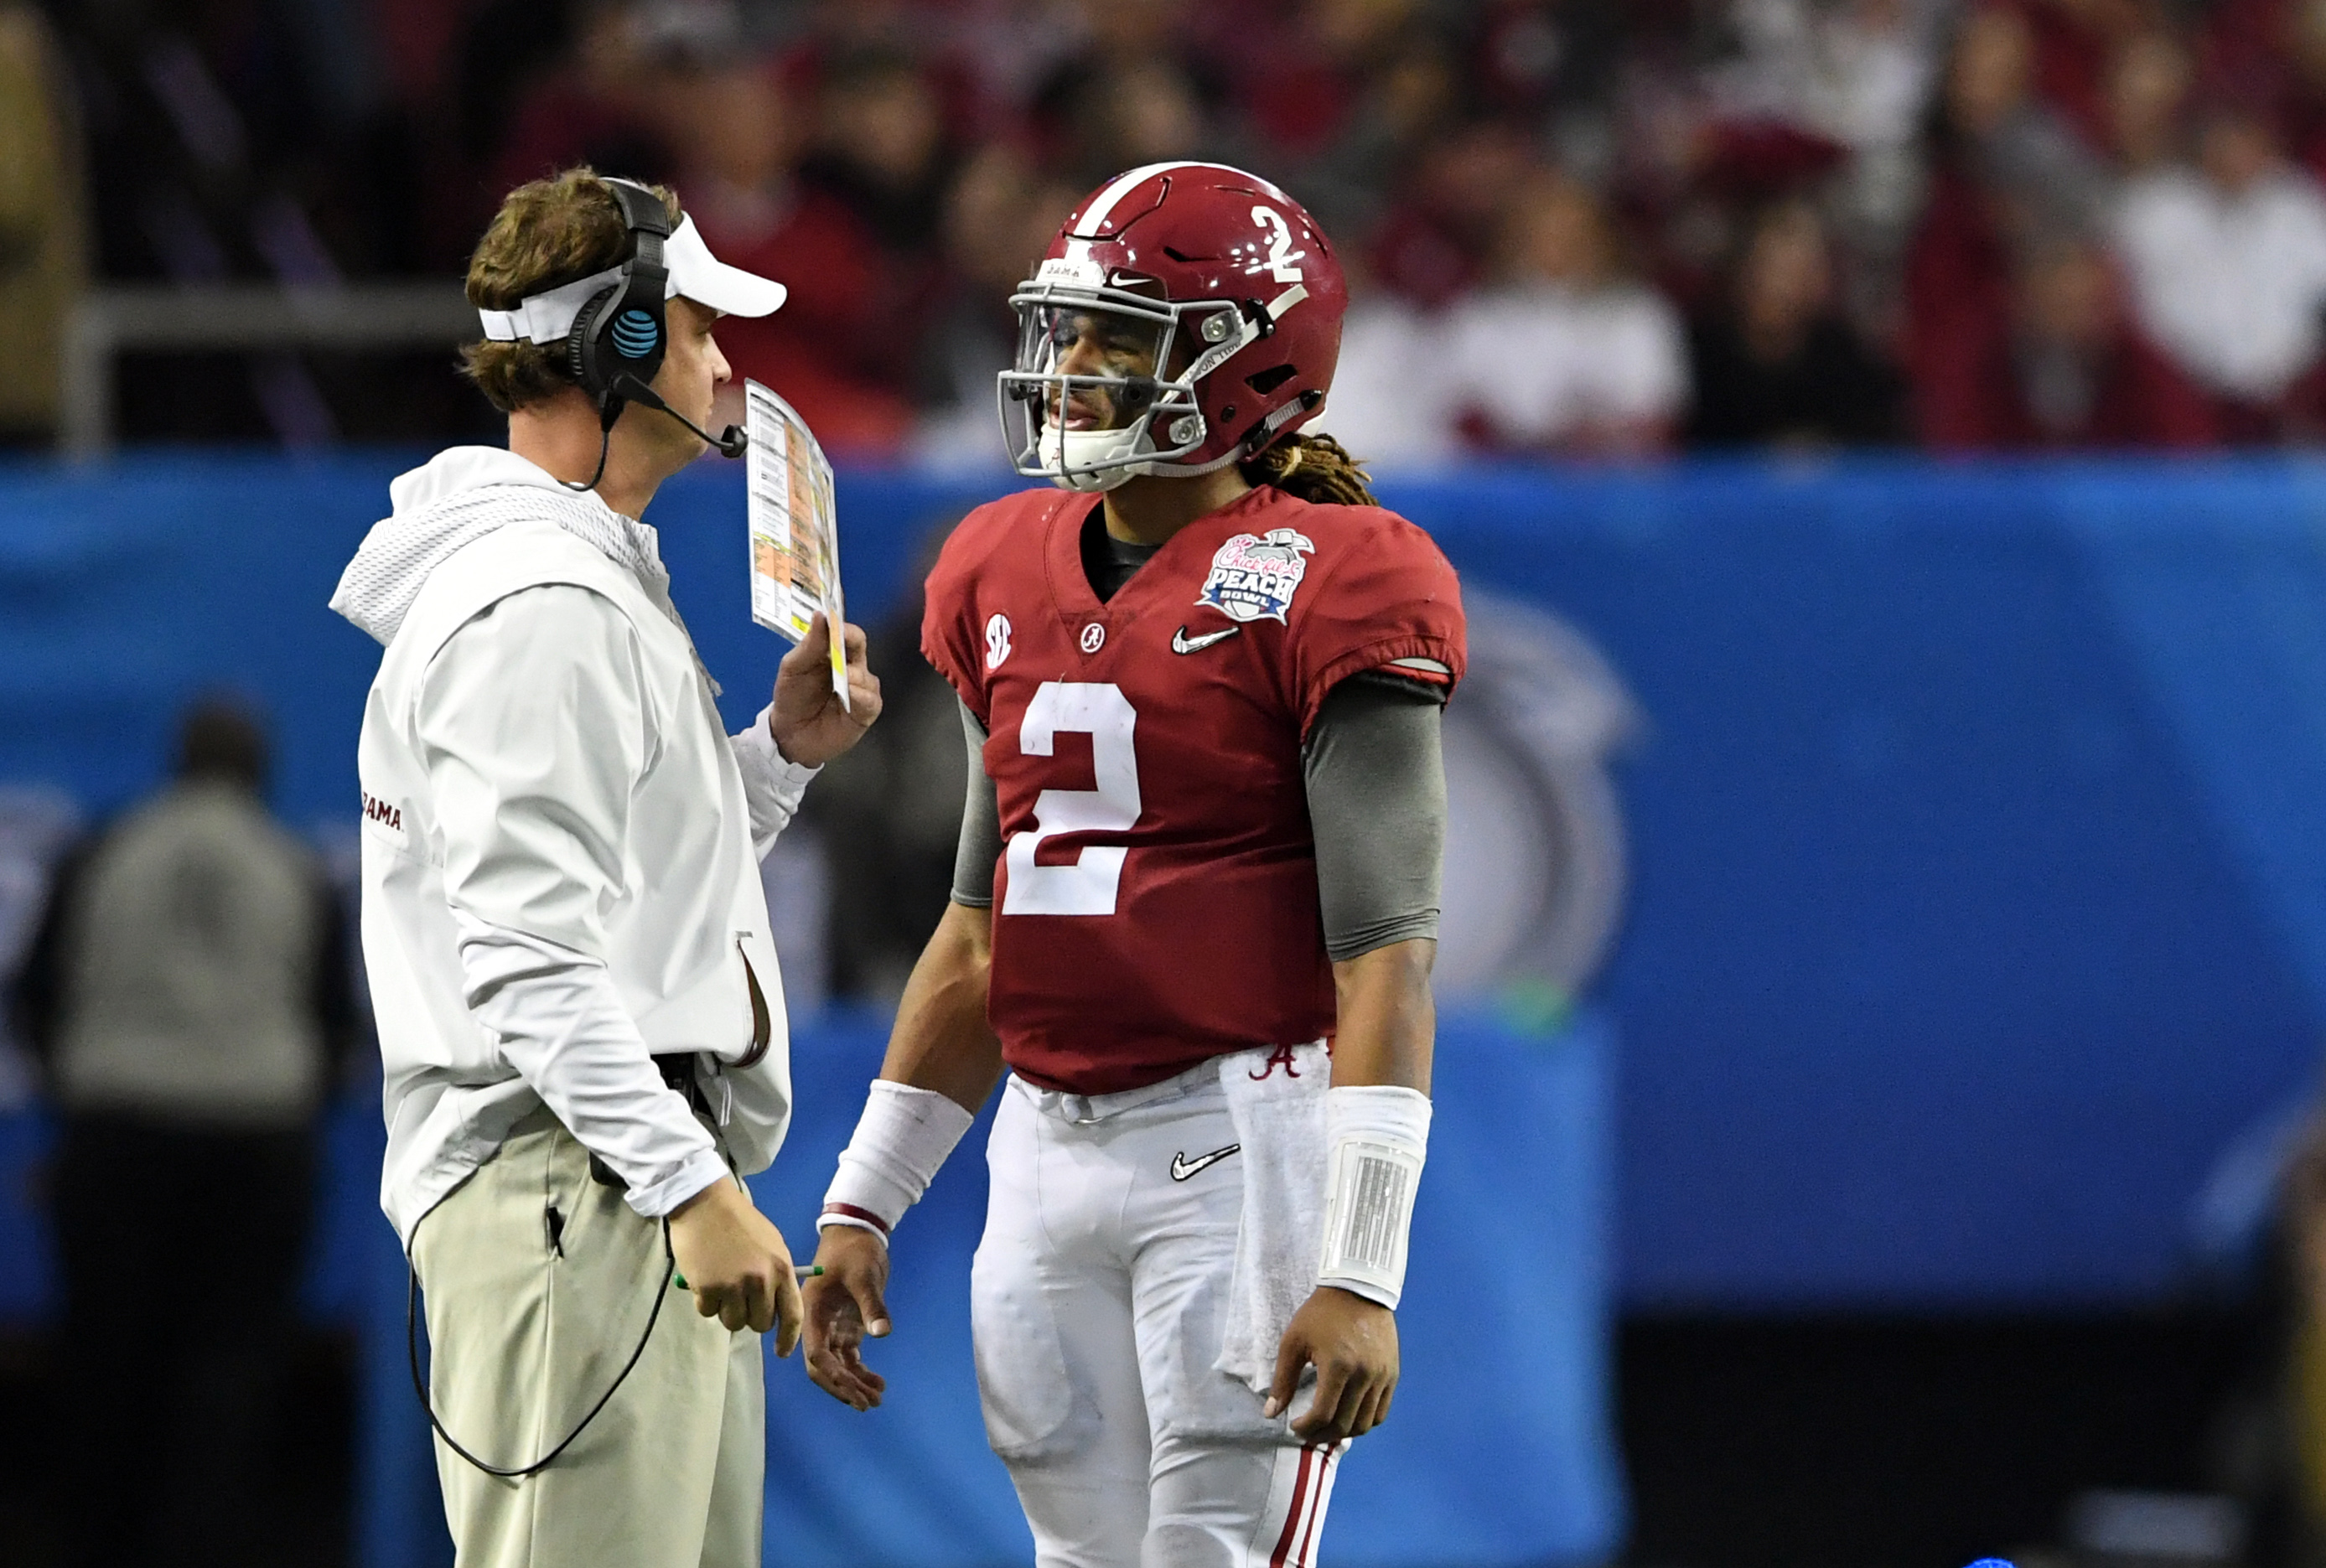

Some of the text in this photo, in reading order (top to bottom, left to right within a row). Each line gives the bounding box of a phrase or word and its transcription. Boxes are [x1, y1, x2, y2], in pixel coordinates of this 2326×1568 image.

[1251, 205, 1303, 283] 2
[1207, 569, 1295, 604] PEACH
[1220, 590, 1270, 608] BOWL
[986, 613, 1012, 669] SEC
[1083, 625, 1101, 649] A
[1002, 681, 1142, 916] 2
